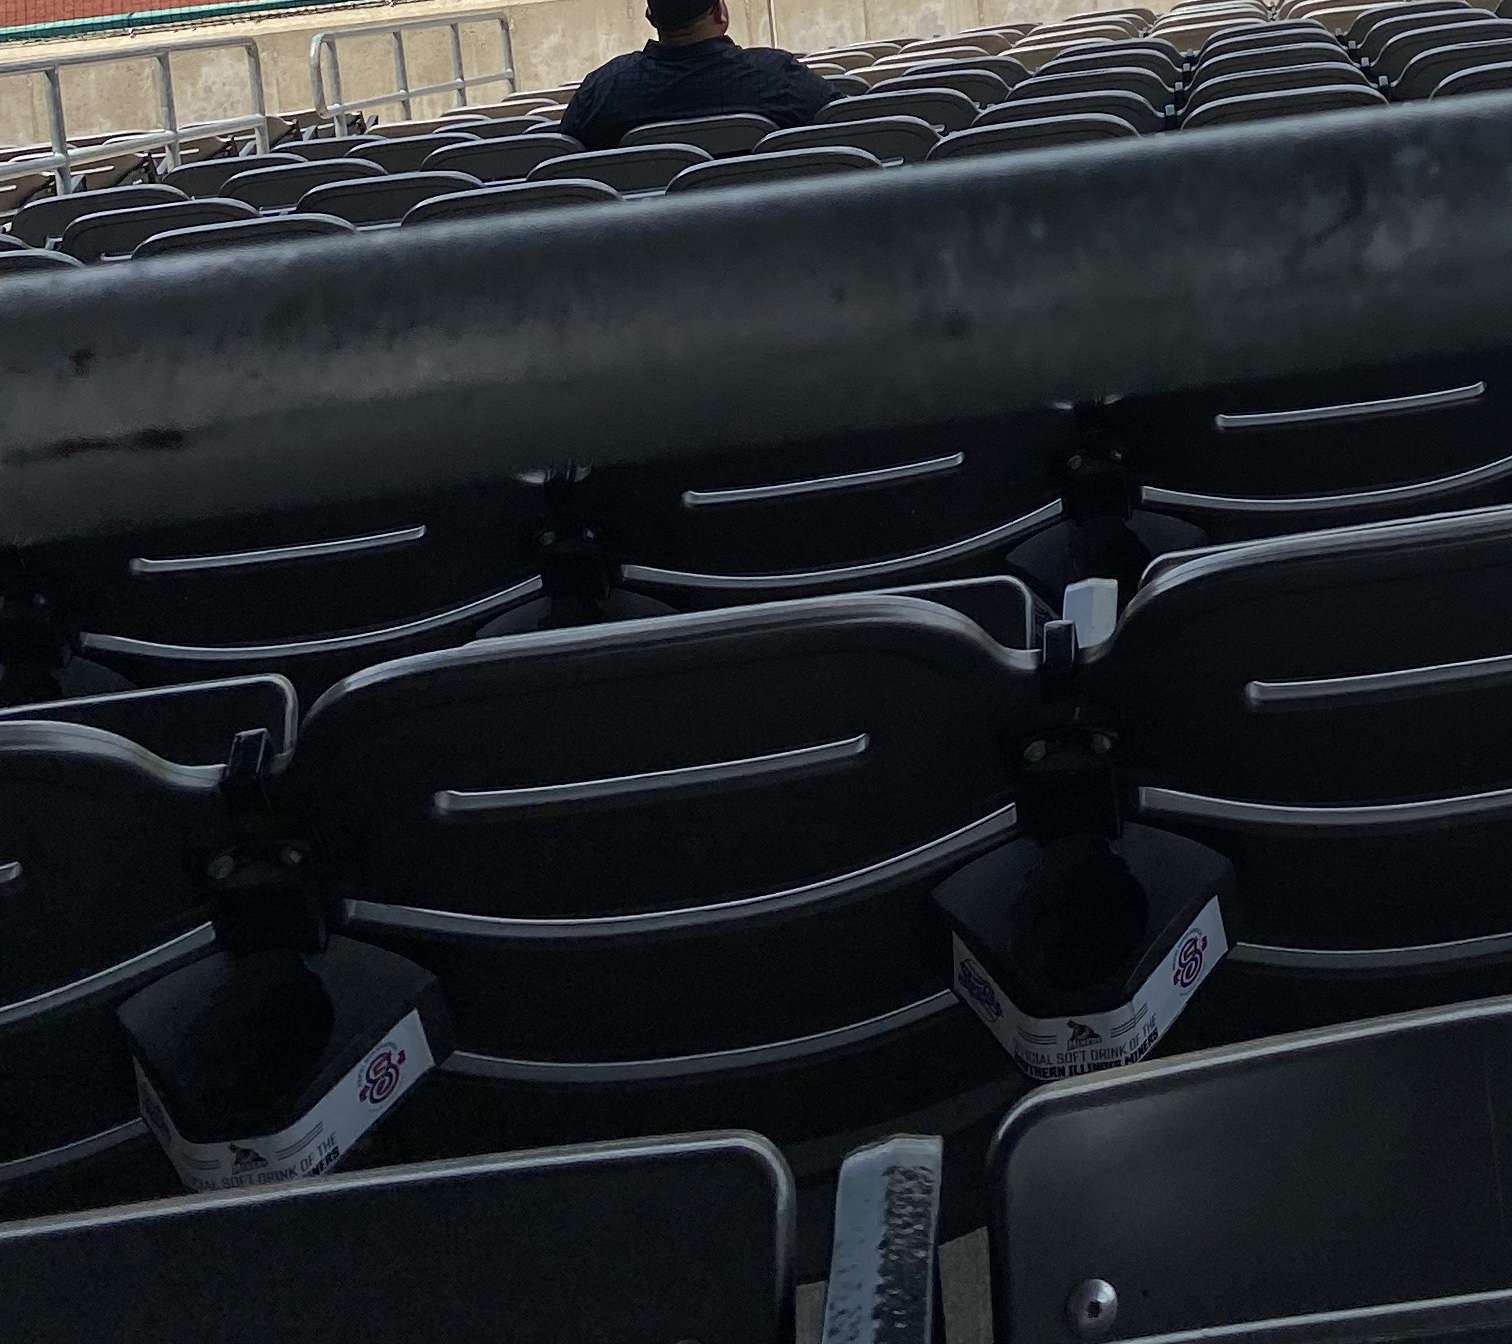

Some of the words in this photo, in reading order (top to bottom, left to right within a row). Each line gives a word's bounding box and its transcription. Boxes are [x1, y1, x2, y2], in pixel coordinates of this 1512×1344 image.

[1056, 1049, 1087, 1064] SOFT
[1090, 1044, 1127, 1061] DRINK
[1129, 1033, 1140, 1049] OF
[1142, 1013, 1157, 1037] THE
[1124, 1026, 1160, 1066] MINERS
[222, 1174, 253, 1189] SOFT
[257, 1165, 298, 1185] DRINK
[300, 1155, 315, 1172] OF
[317, 1132, 336, 1157] THE
